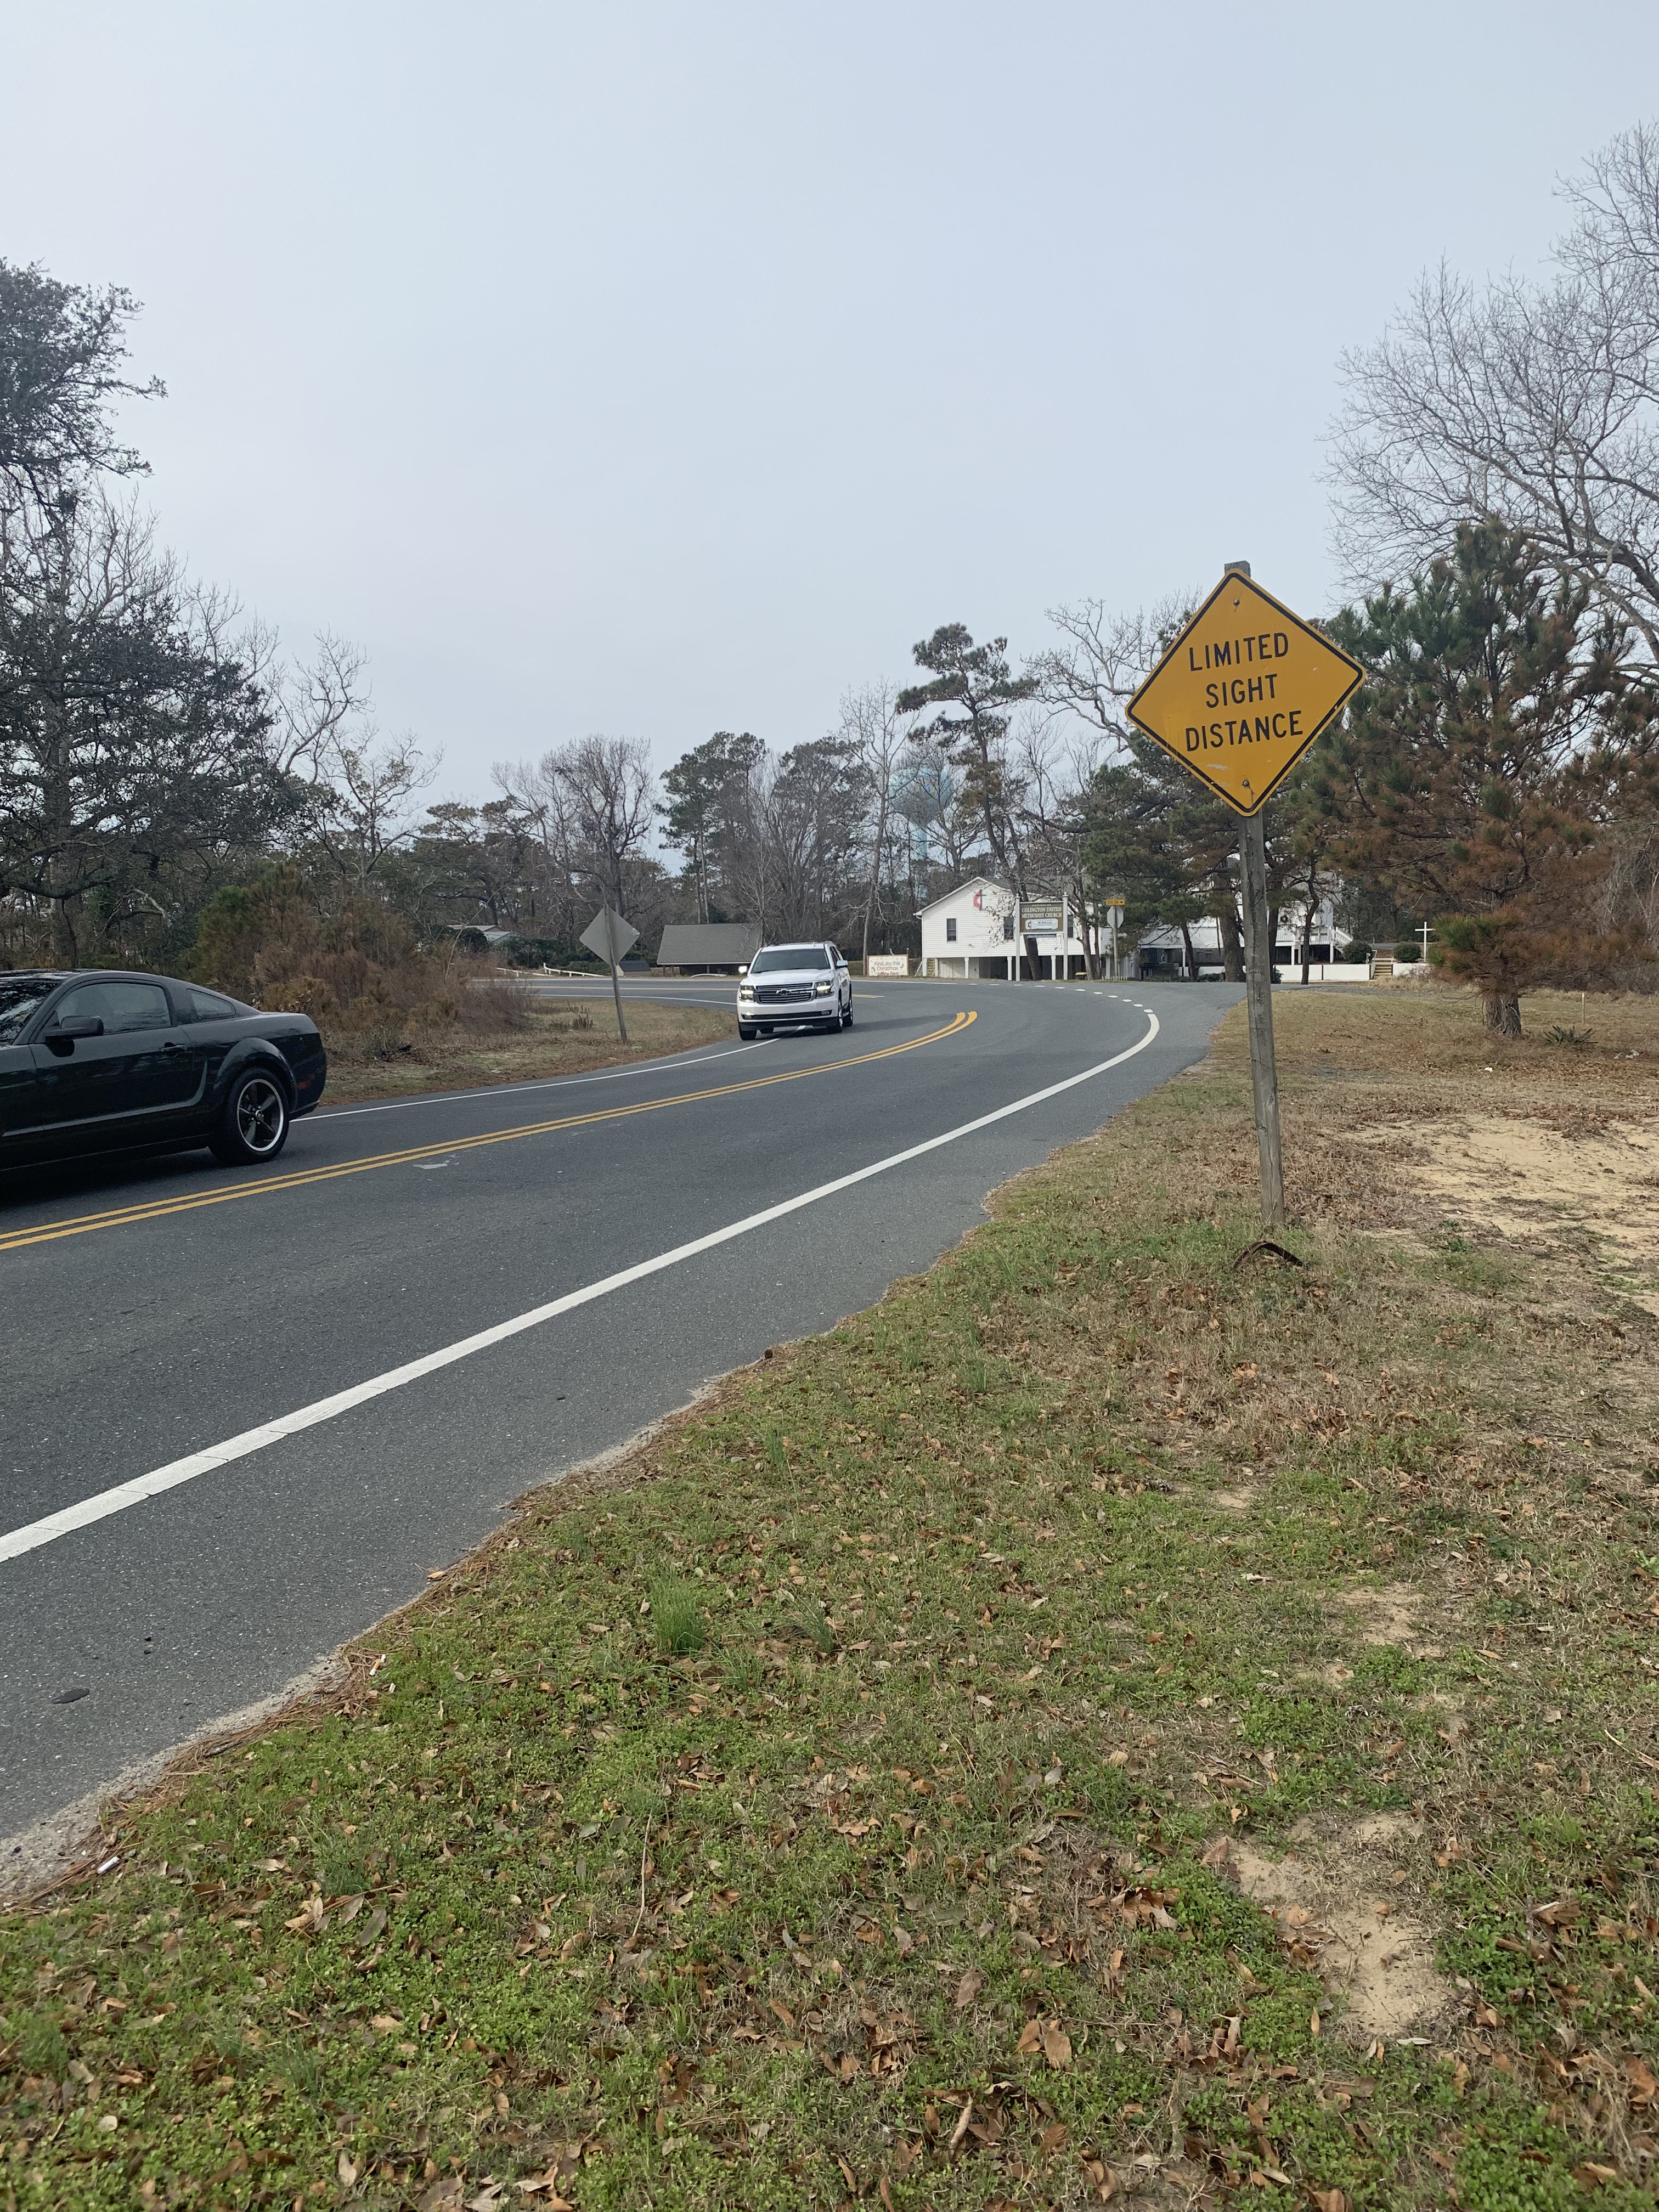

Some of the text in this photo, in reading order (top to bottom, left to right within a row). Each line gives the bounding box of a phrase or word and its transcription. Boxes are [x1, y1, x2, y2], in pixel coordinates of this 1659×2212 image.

[1189, 632, 1289, 672] LIMITED
[1205, 673, 1278, 708] SIGHT
[1185, 710, 1304, 752] DISTANCE
